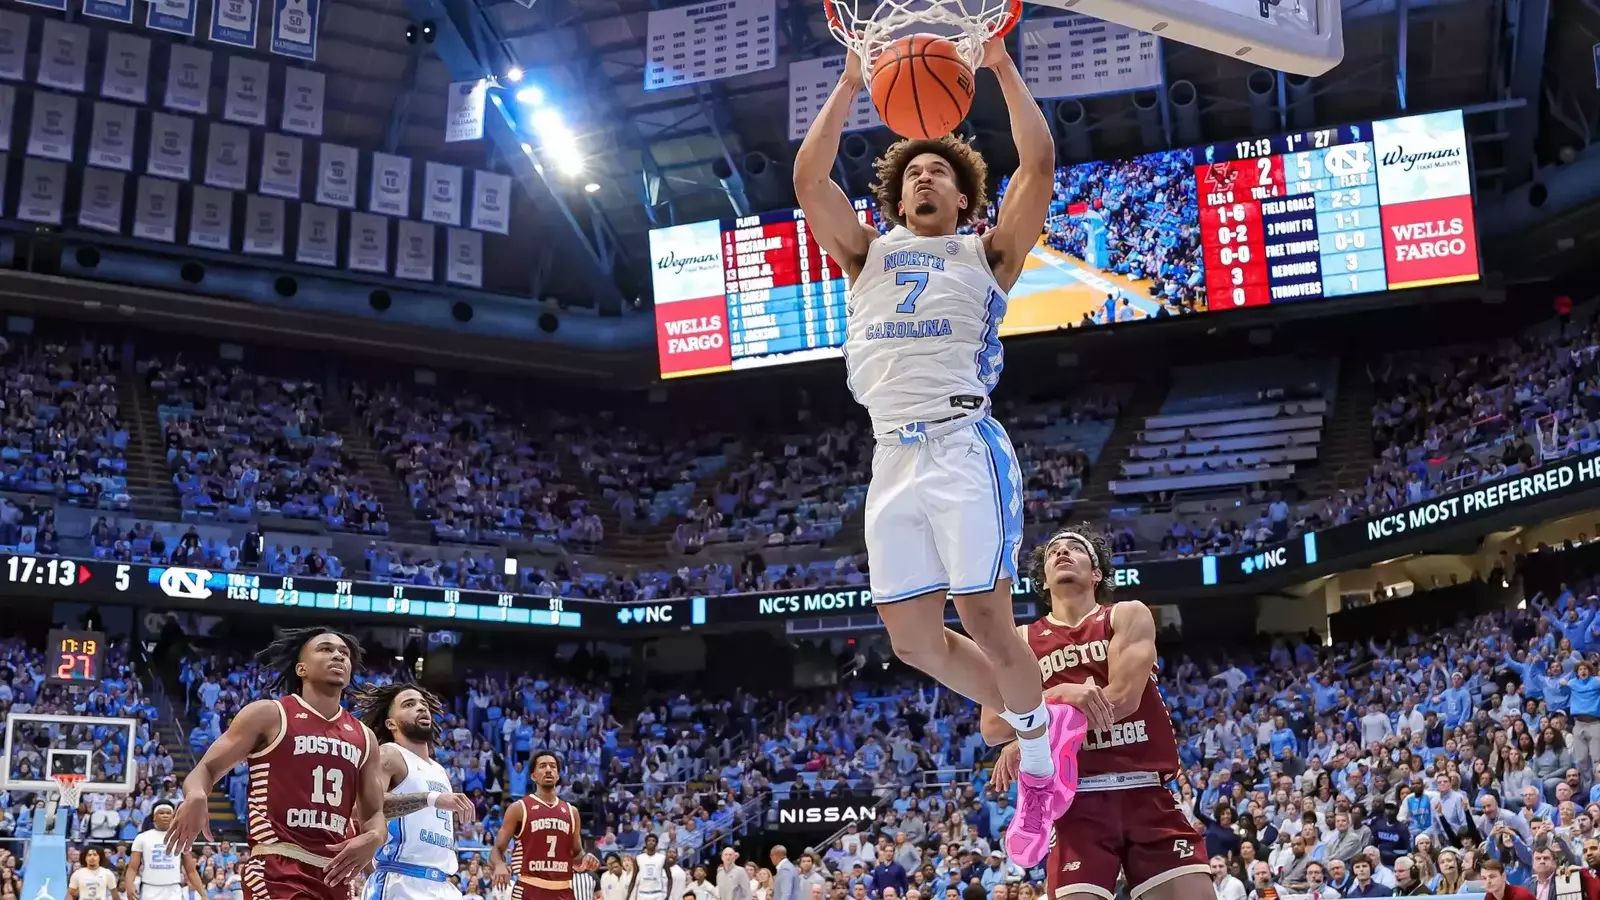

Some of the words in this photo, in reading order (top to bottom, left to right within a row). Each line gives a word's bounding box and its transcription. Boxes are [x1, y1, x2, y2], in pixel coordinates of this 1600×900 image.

[1236, 139, 1272, 159] 17:13
[1314, 130, 1330, 148] 27
[1257, 158, 1272, 185] 2
[1296, 153, 1312, 180] 5
[1382, 144, 1460, 172] Wegmans
[1218, 206, 1246, 224] 1-6
[1262, 195, 1287, 216] FIELD
[1288, 193, 1314, 211] GOALS
[1331, 189, 1358, 208] 2-3
[1218, 224, 1248, 244] 0-2
[1268, 223, 1274, 236] 3
[1276, 220, 1301, 236] POINT
[1302, 218, 1314, 232] FG
[1335, 209, 1360, 229] 1-1
[1392, 218, 1464, 242] WELLS
[1220, 245, 1250, 266] 0-0
[1266, 242, 1286, 258] FREE
[1287, 240, 1320, 256] THROWS
[1335, 231, 1366, 250] 0-0
[1396, 238, 1466, 262] FARGO
[656, 251, 719, 274] Wegmans
[884, 251, 945, 272] NORTH
[1231, 268, 1244, 286] 3
[1272, 261, 1318, 278] REBOUNDS
[1346, 254, 1358, 271] 3
[896, 272, 929, 314] 7
[1232, 288, 1246, 306] 0
[1271, 282, 1322, 300] TURNOVERS
[1348, 274, 1358, 292] 1
[664, 315, 722, 336] WELLS
[866, 318, 952, 340] CAROLINA
[668, 334, 724, 354] FARGO
[1368, 513, 1406, 540] NC'S
[1410, 498, 1459, 530] MOST
[1463, 466, 1574, 514] PREFERRED
[1264, 548, 1286, 570] NC
[7, 556, 76, 587] 17:13
[115, 564, 131, 591] 5
[282, 576, 294, 590] FG
[336, 582, 352, 596] 3PT
[393, 586, 404, 600] FT
[549, 598, 563, 612] STL
[760, 596, 800, 614] NC'S
[803, 591, 858, 612] MOST
[646, 606, 672, 622] NC
[61, 638, 96, 655] 17:13
[58, 655, 92, 680] 27
[1020, 714, 1034, 728] 7
[1082, 720, 1149, 751] LLEGE
[294, 735, 362, 768] BOSTON
[311, 765, 344, 808] 13
[531, 818, 570, 834] BOSTON
[780, 806, 876, 824] NISSAN
[546, 836, 558, 858] 7
[529, 860, 568, 873] COLLEGE
